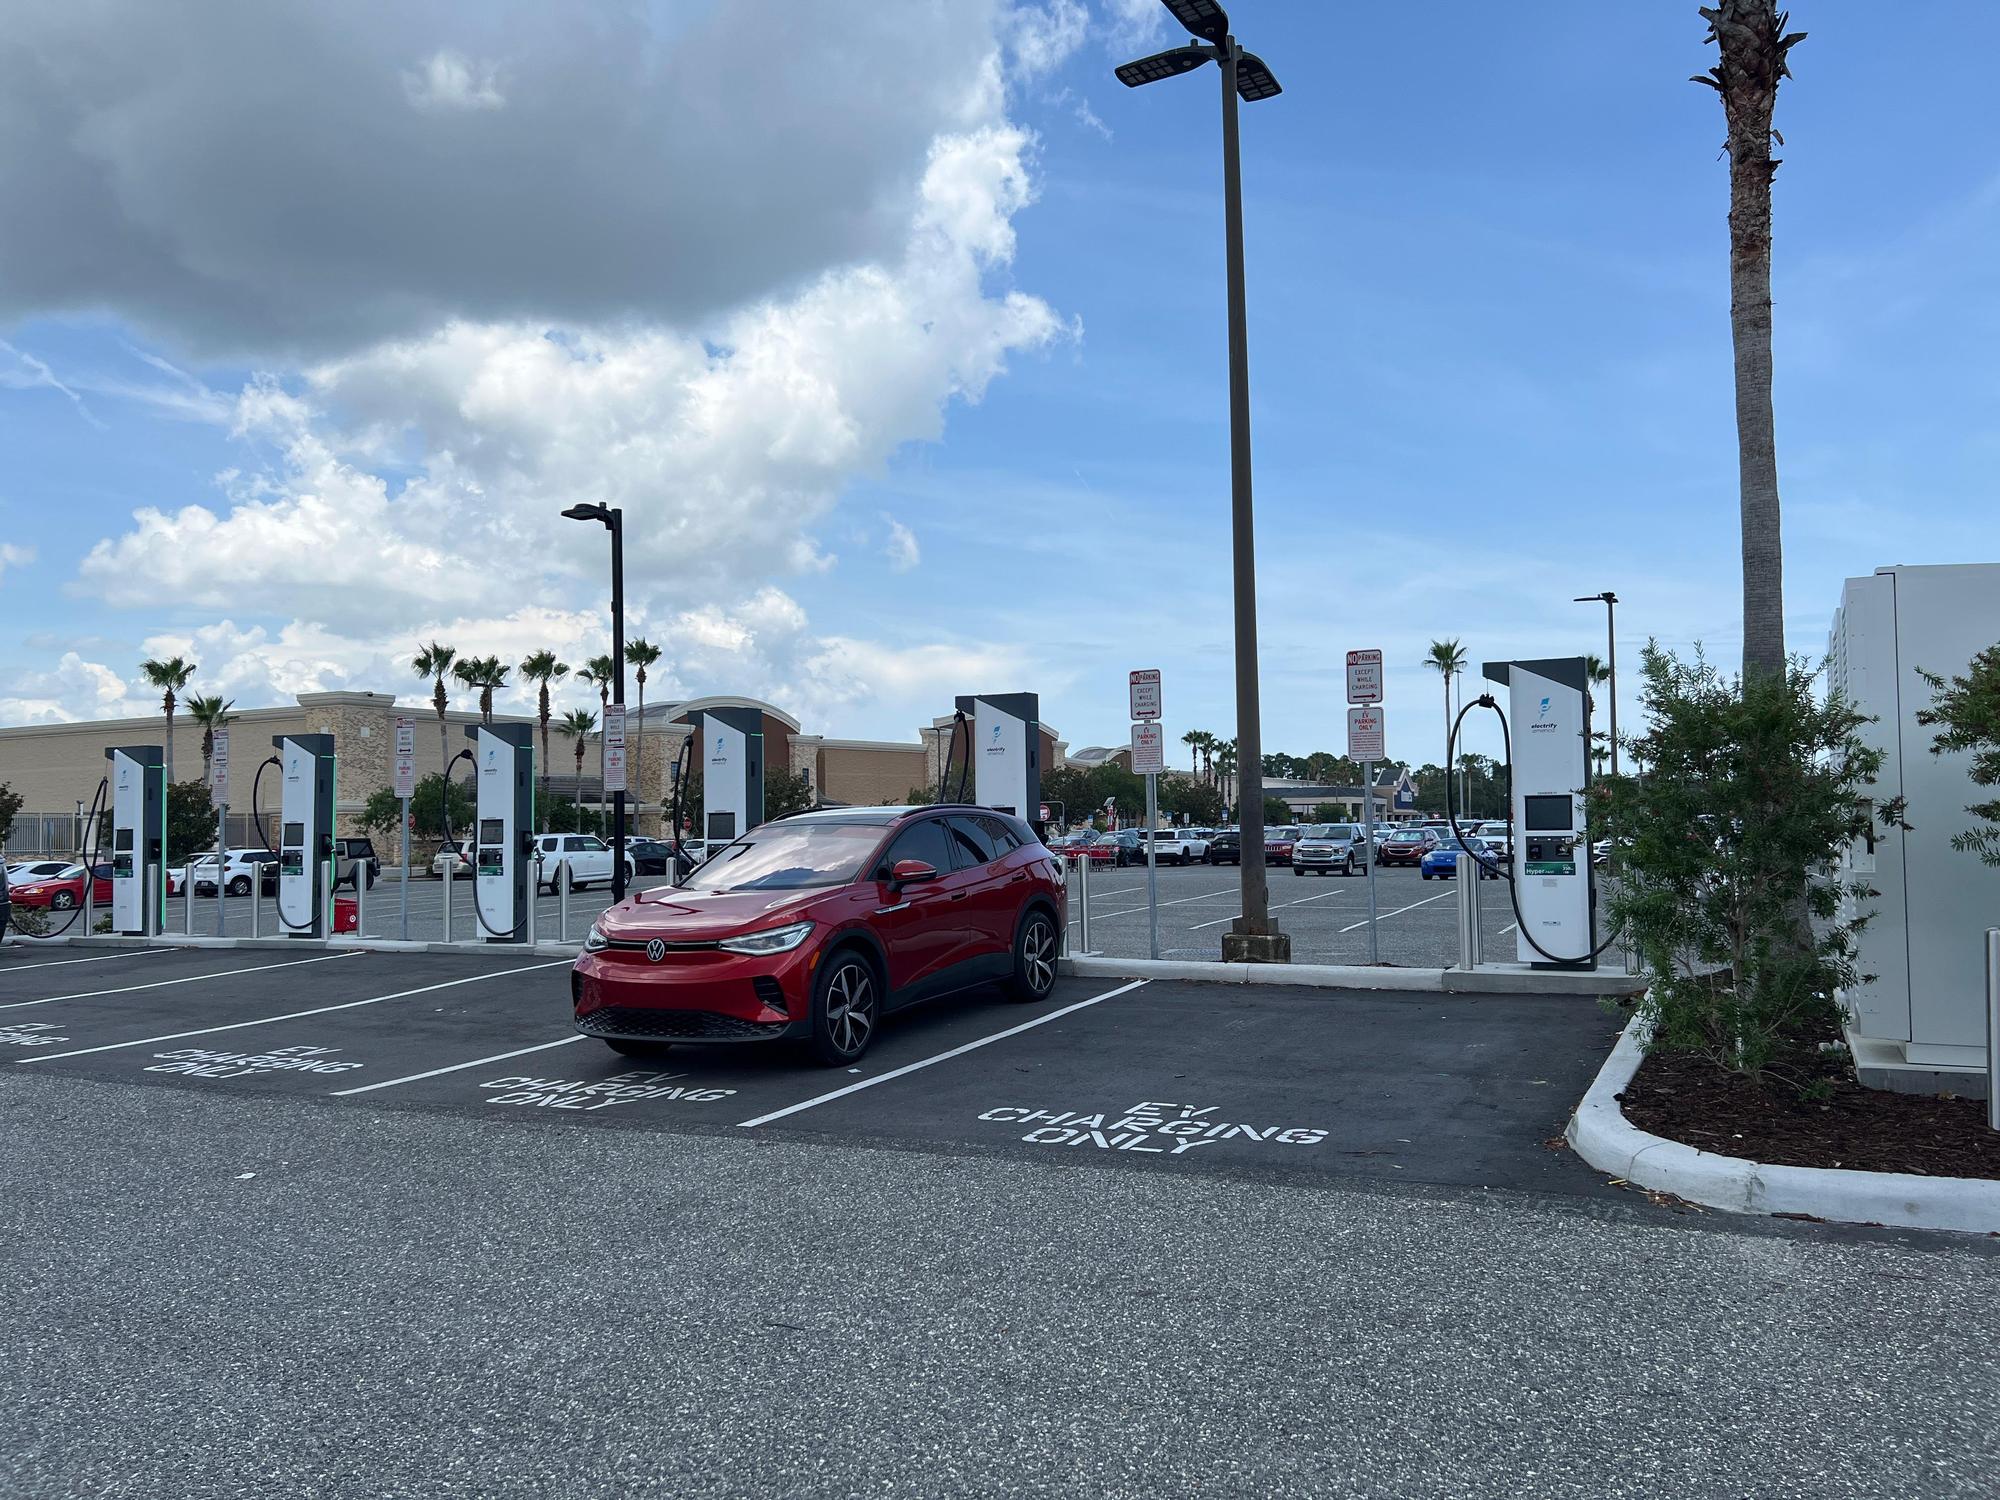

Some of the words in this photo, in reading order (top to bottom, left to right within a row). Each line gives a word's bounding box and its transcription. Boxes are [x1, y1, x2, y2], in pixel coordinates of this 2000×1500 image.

[1347, 653, 1357, 664] NO
[1358, 653, 1380, 662] PARKING
[1131, 673, 1139, 683] NO
[1140, 673, 1159, 681] PARKING
[1352, 683, 1378, 691] CHARGING
[266, 1045, 343, 1057] EV
[153, 1048, 365, 1074] CHARGING
[143, 1061, 273, 1079] ONLY
[605, 1070, 689, 1084] EV
[479, 1076, 738, 1102] CHARGING
[485, 1091, 639, 1110] ONLY
[1123, 1101, 1221, 1118] EV
[977, 1107, 1331, 1145] CHARGING
[1021, 1127, 1218, 1154] ONLY
